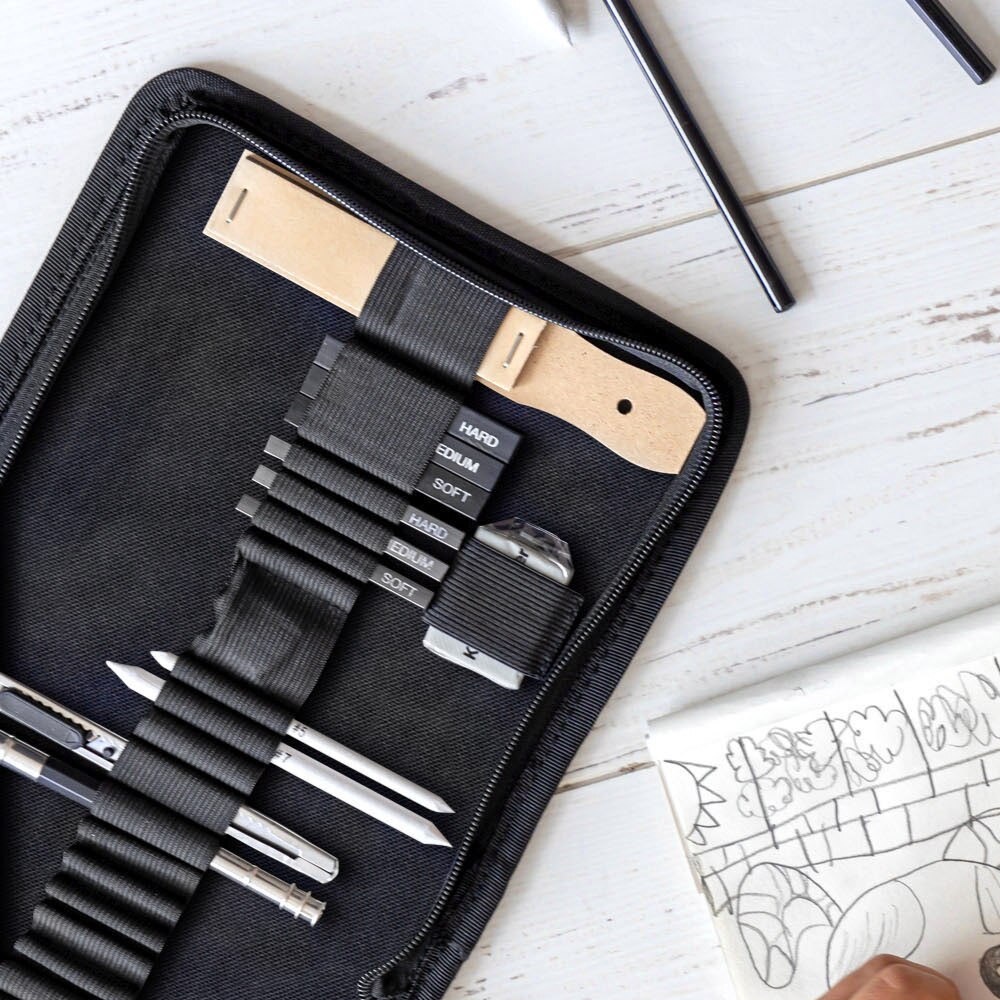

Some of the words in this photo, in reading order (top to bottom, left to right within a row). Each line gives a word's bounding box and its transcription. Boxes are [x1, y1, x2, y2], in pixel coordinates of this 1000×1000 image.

[459, 421, 499, 448] HARD
[435, 443, 480, 473] EDIUM
[432, 478, 472, 503] SOFT
[408, 513, 448, 540] HARD
[388, 541, 435, 570] EDIUM
[381, 572, 418, 597] SOFT
